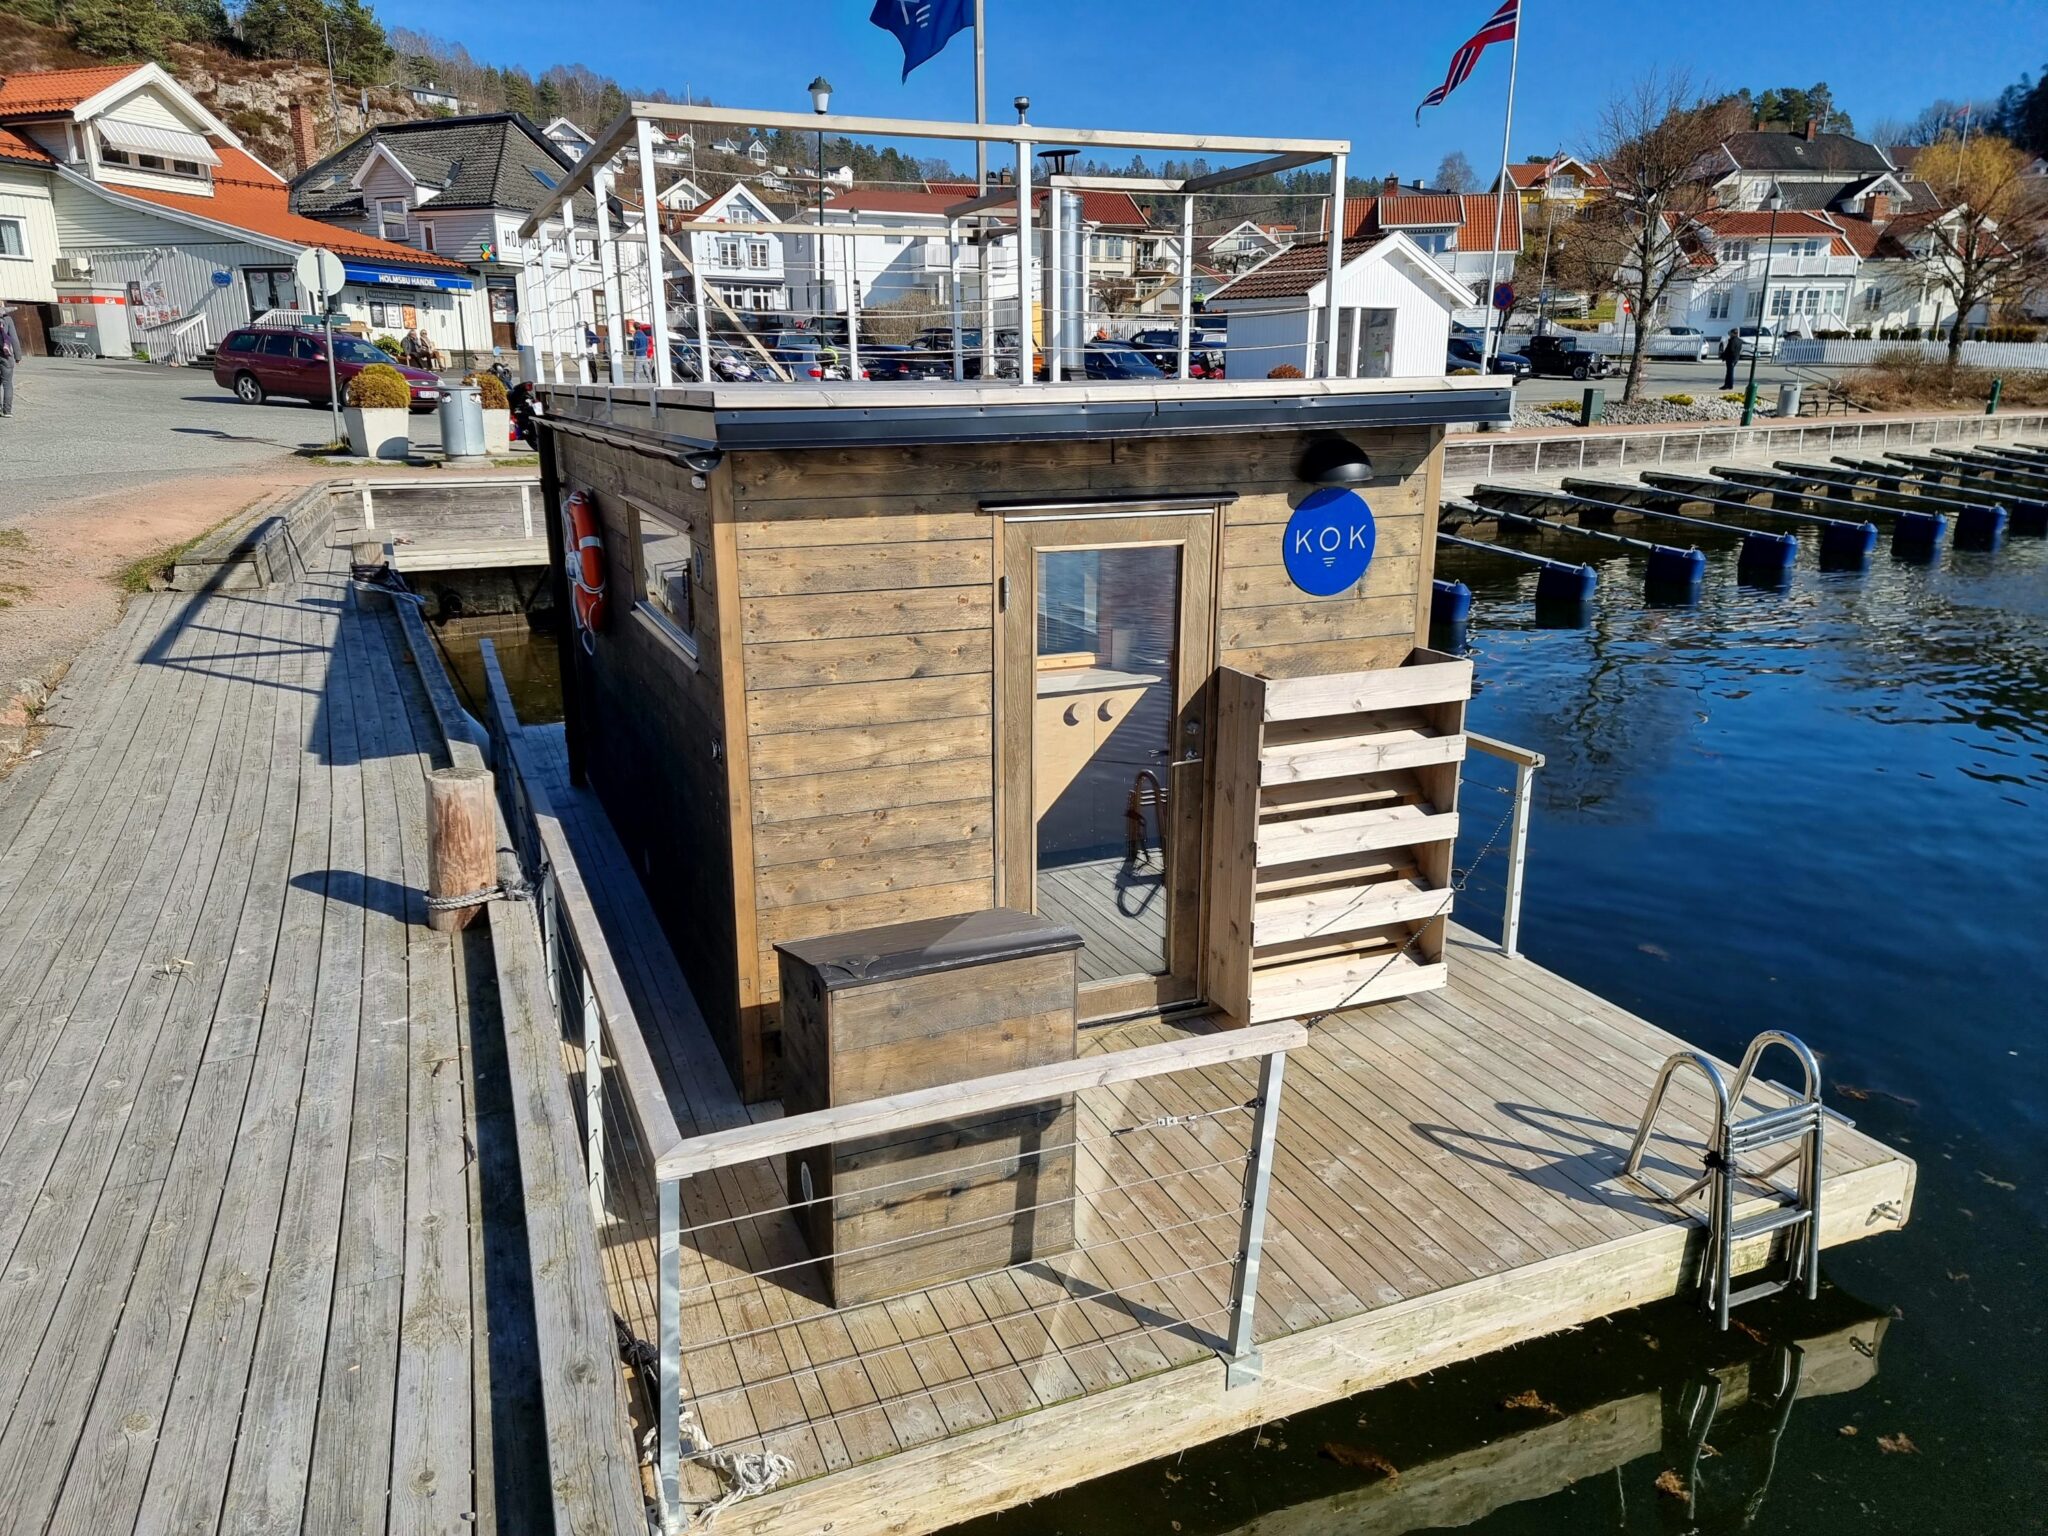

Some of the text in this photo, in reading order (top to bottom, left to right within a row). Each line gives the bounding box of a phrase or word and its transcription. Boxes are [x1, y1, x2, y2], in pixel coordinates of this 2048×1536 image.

[379, 274, 437, 287] HOLMSBU HANDEL
[1296, 524, 1367, 554] KOK
